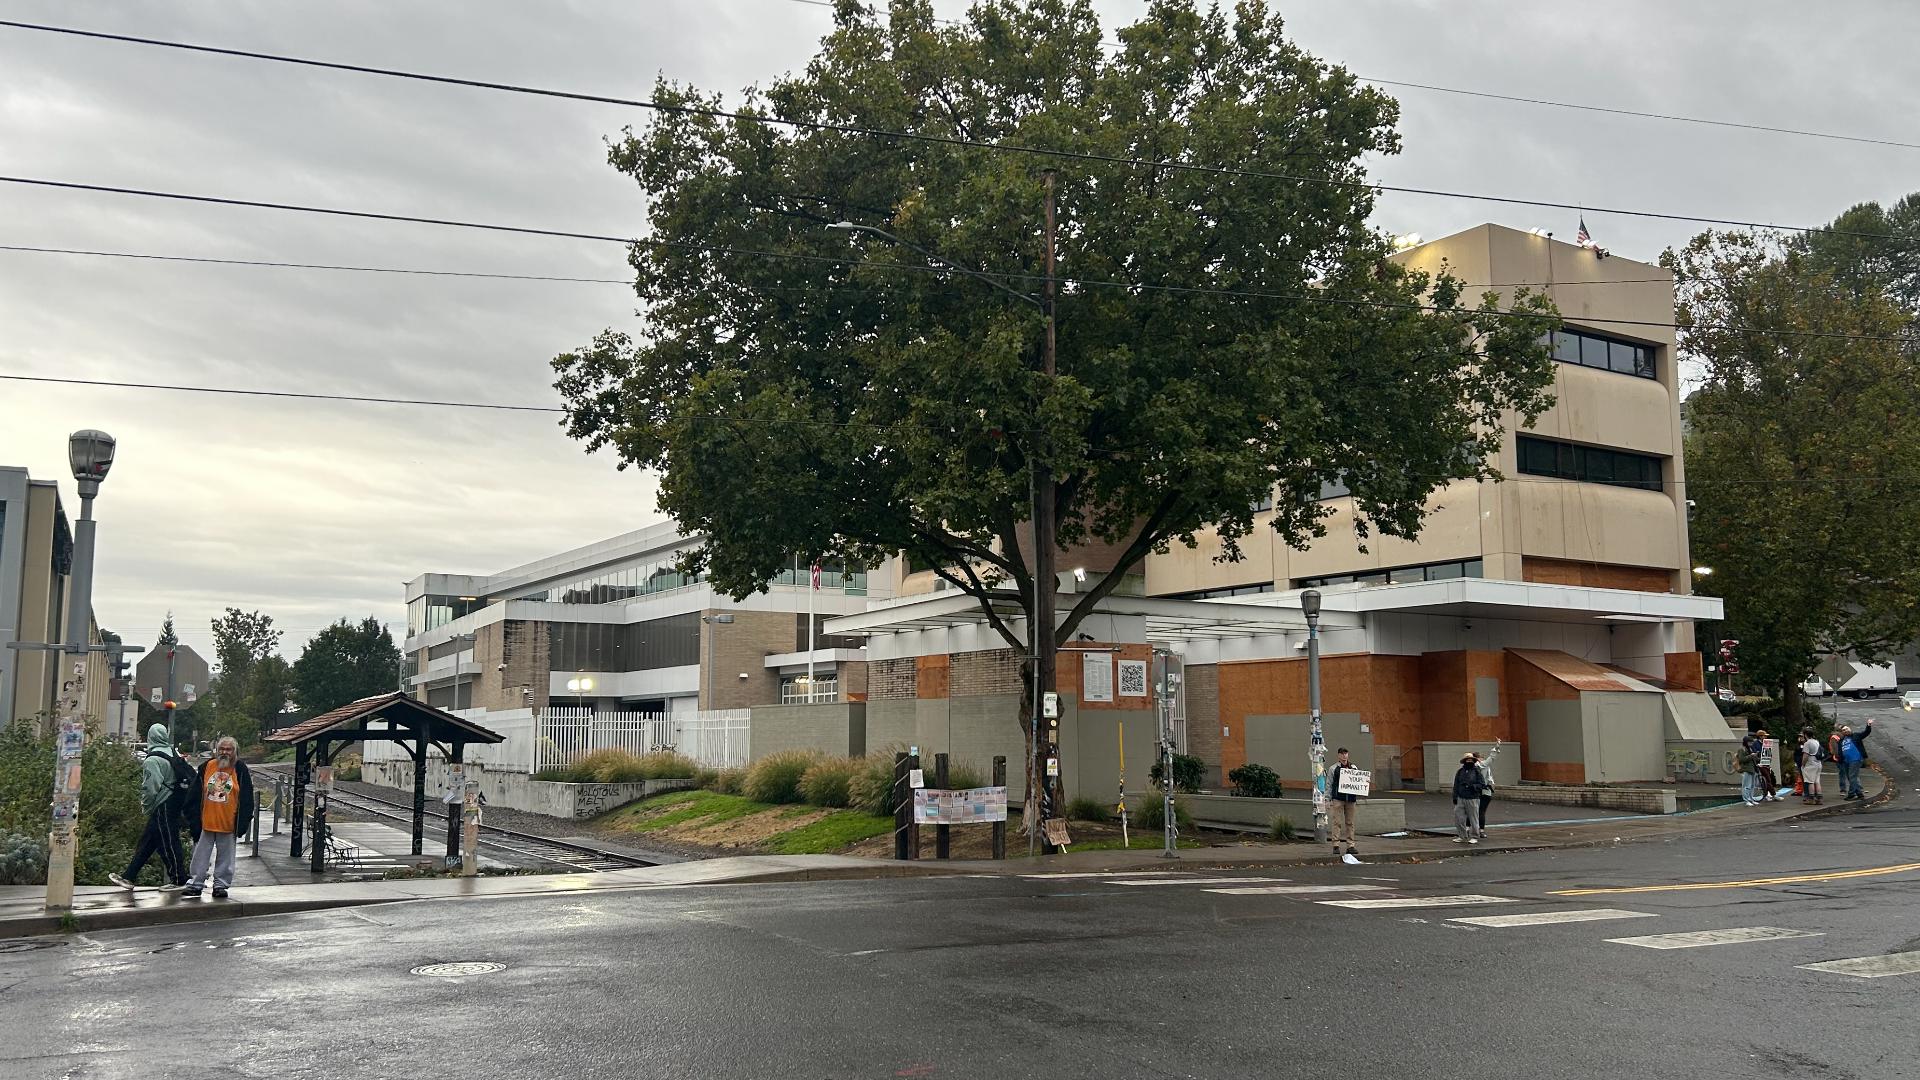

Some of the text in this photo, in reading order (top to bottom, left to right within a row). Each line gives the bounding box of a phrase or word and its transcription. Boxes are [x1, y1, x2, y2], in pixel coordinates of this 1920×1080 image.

[1666, 750, 1737, 774] 4310
[578, 796, 605, 806] MELT
[576, 806, 604, 817] ICE
[293, 817, 302, 839] US
